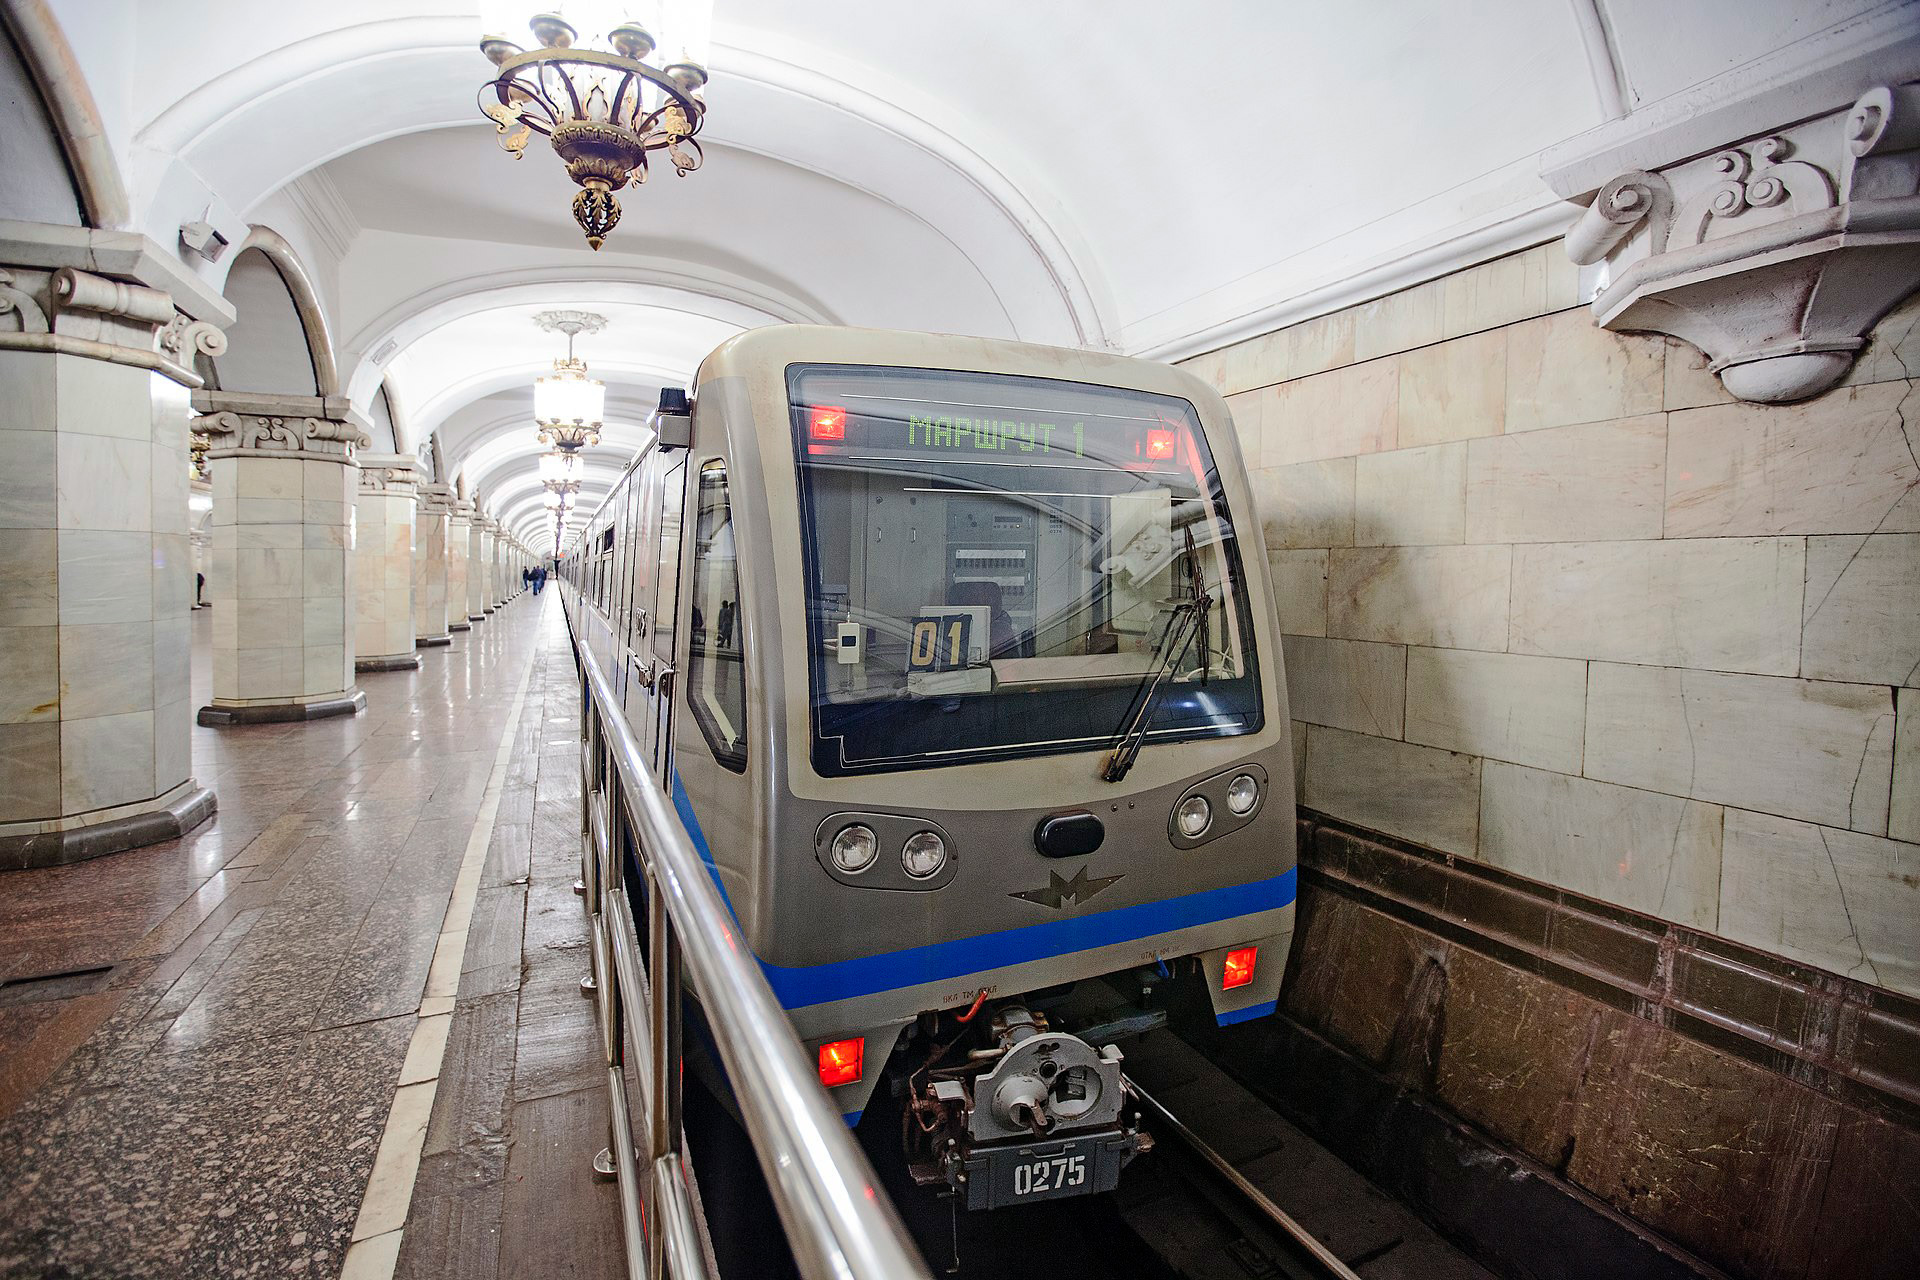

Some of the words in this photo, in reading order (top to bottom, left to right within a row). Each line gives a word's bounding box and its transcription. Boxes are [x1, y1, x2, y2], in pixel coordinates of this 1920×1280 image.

[909, 415, 1056, 453] МАРШРУТ
[1073, 421, 1084, 459] 1
[911, 621, 962, 666] 01
[1014, 1155, 1086, 1195] 0275
